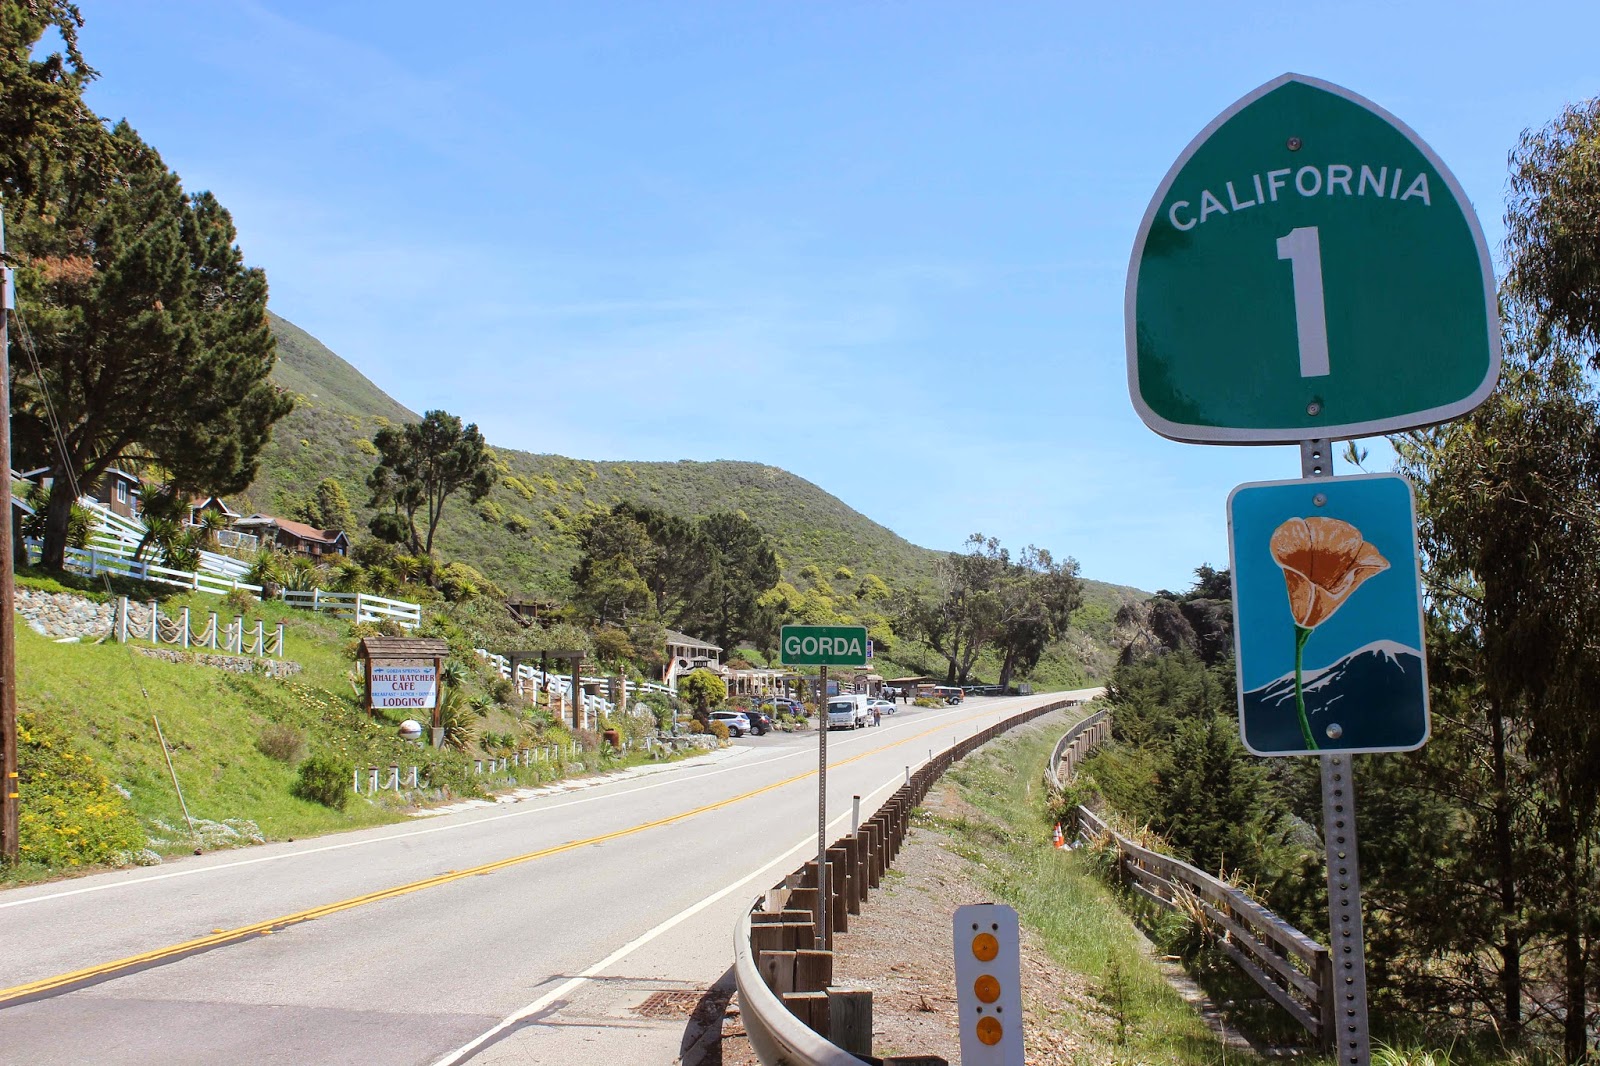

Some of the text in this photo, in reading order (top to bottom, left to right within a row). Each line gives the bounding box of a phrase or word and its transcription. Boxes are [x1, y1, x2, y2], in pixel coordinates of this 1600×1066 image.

[1168, 164, 1432, 232] CALIFORNIA
[1276, 226, 1331, 378] 1
[784, 636, 863, 656] GORDA
[372, 674, 435, 682] WHALE WATCHER
[391, 682, 416, 691] CAFE
[383, 697, 425, 707] LODGING
